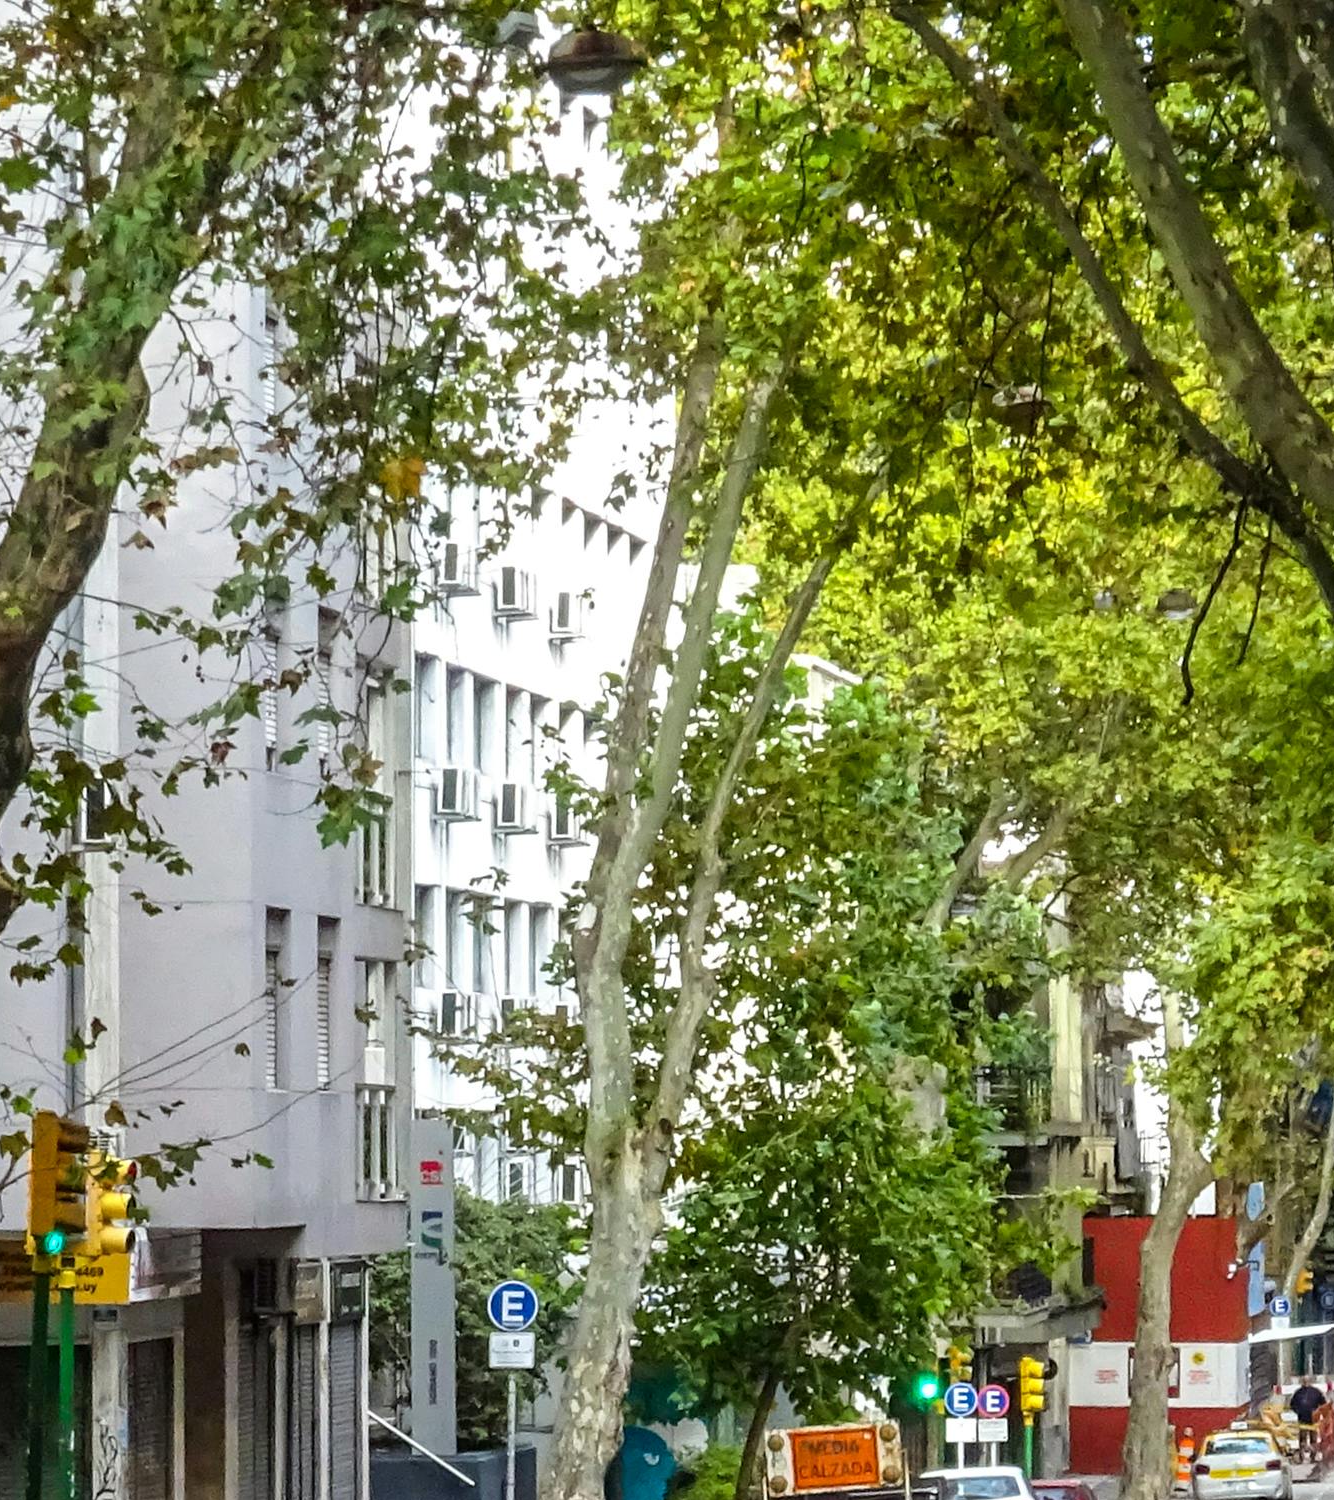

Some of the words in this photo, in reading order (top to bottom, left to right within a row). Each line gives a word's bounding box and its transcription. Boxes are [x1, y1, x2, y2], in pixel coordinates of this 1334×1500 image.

[502, 1290, 525, 1322] E
[1274, 1299, 1286, 1312] E
[953, 1387, 969, 1408] E
[986, 1391, 1001, 1412] E
[803, 1440, 860, 1456] MEDIA
[799, 1462, 873, 1479] CALZADA
